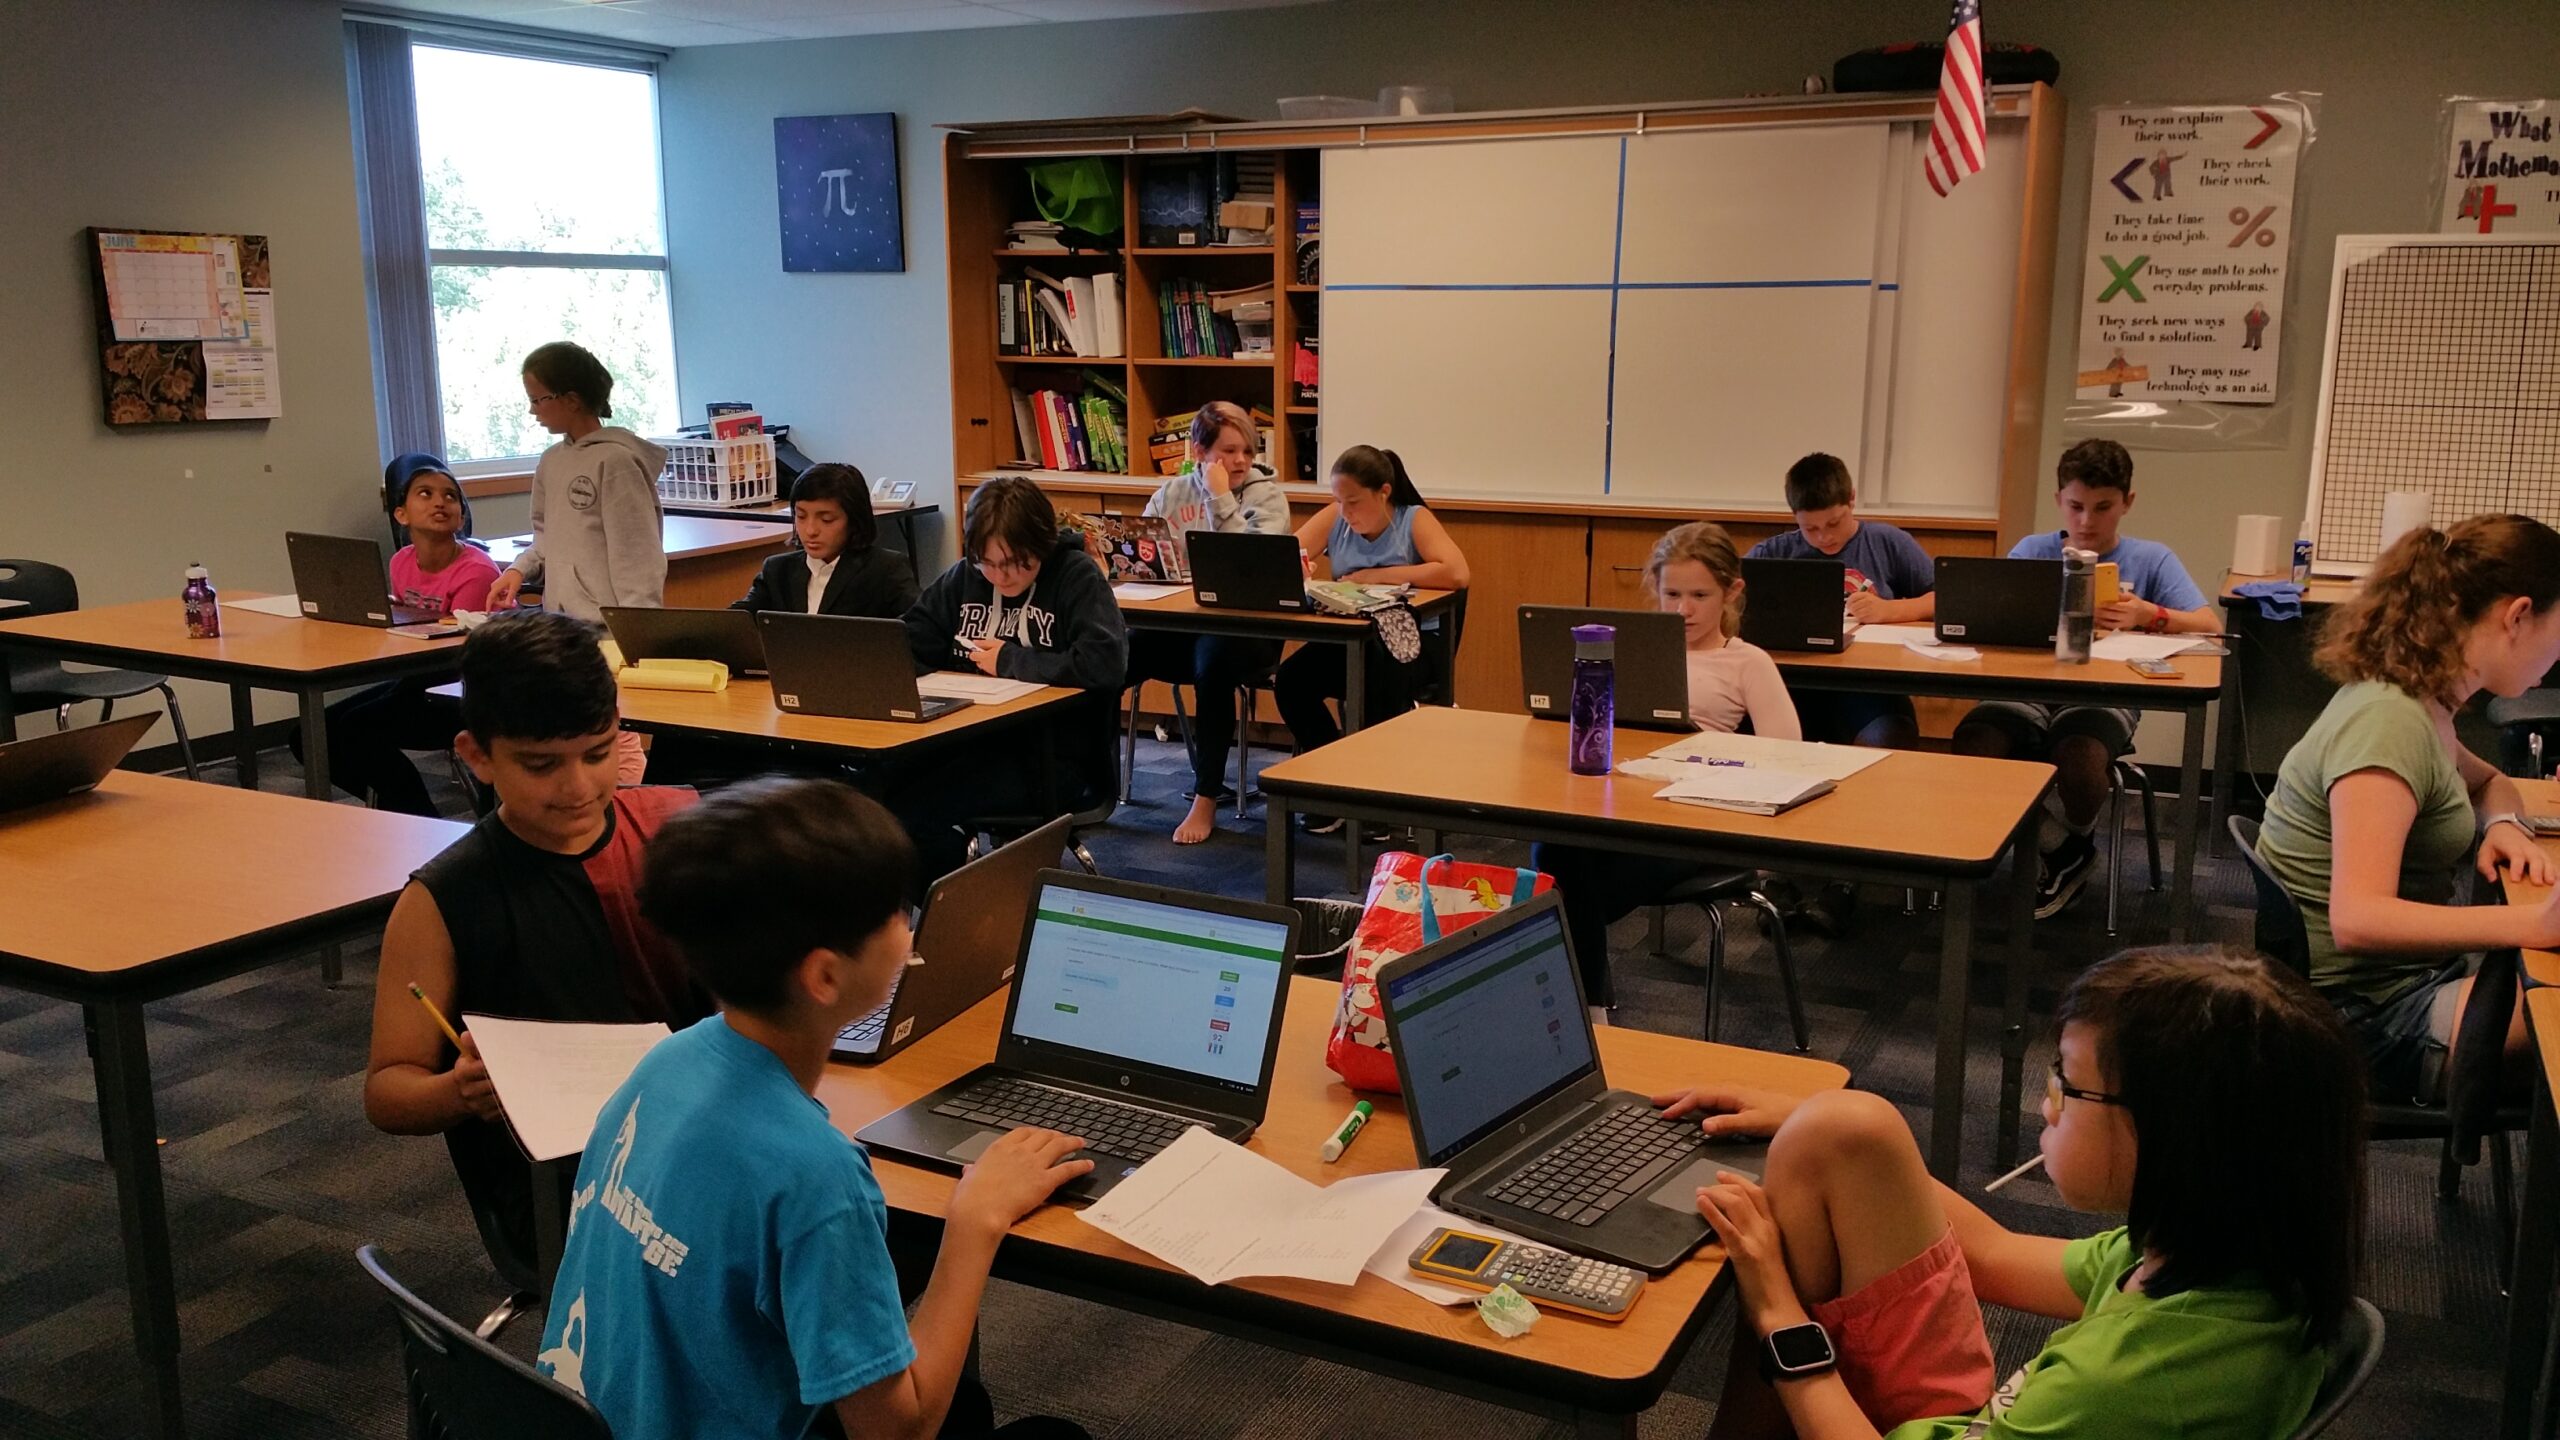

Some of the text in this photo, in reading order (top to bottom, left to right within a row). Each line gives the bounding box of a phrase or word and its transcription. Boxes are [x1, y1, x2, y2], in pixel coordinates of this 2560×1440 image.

[2120, 112, 2224, 128] They can explain
[2490, 111, 2552, 143] What
[2135, 130, 2203, 142] their work.
[2203, 157, 2272, 173] They check
[2200, 174, 2270, 186] their work.
[2114, 214, 2205, 229] They take time
[2105, 231, 2118, 242] to
[2122, 232, 2138, 242] do
[2152, 230, 2182, 243] good
[2182, 229, 2210, 246] job.
[2148, 263, 2280, 279] They use math to solve
[2152, 280, 2269, 296] everyday problems.
[2098, 315, 2225, 330] They seek new ways
[2103, 331, 2116, 342] to
[2120, 331, 2145, 342] find
[2160, 330, 2217, 343] solution.
[2169, 365, 2251, 380] They may use
[2146, 380, 2270, 396] technology as an aid.
[783, 696, 796, 705] H2
[1534, 698, 1546, 706] H7
